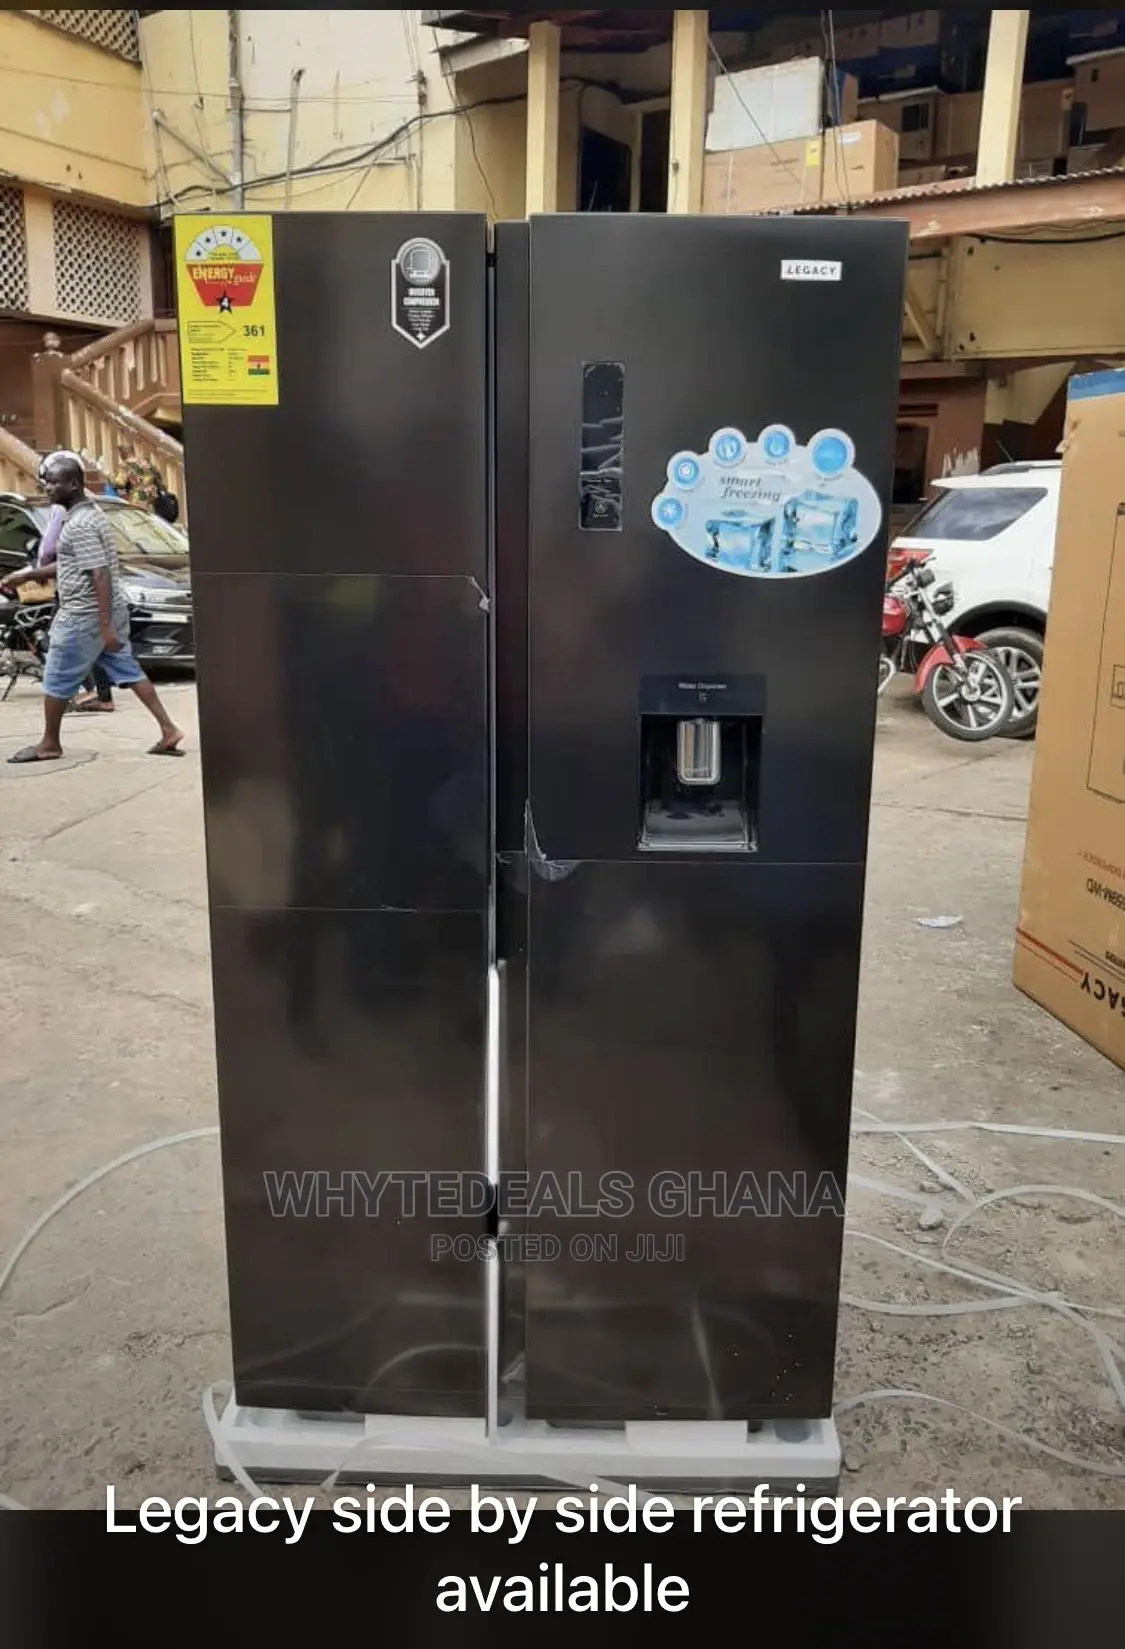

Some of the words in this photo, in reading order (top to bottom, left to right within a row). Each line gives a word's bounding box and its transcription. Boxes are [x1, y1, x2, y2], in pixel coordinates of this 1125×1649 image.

[192, 265, 235, 282] ENERGY
[785, 264, 836, 275] LEGACY
[243, 324, 265, 337] 361
[720, 476, 762, 487] smart
[720, 486, 781, 502] freezing
